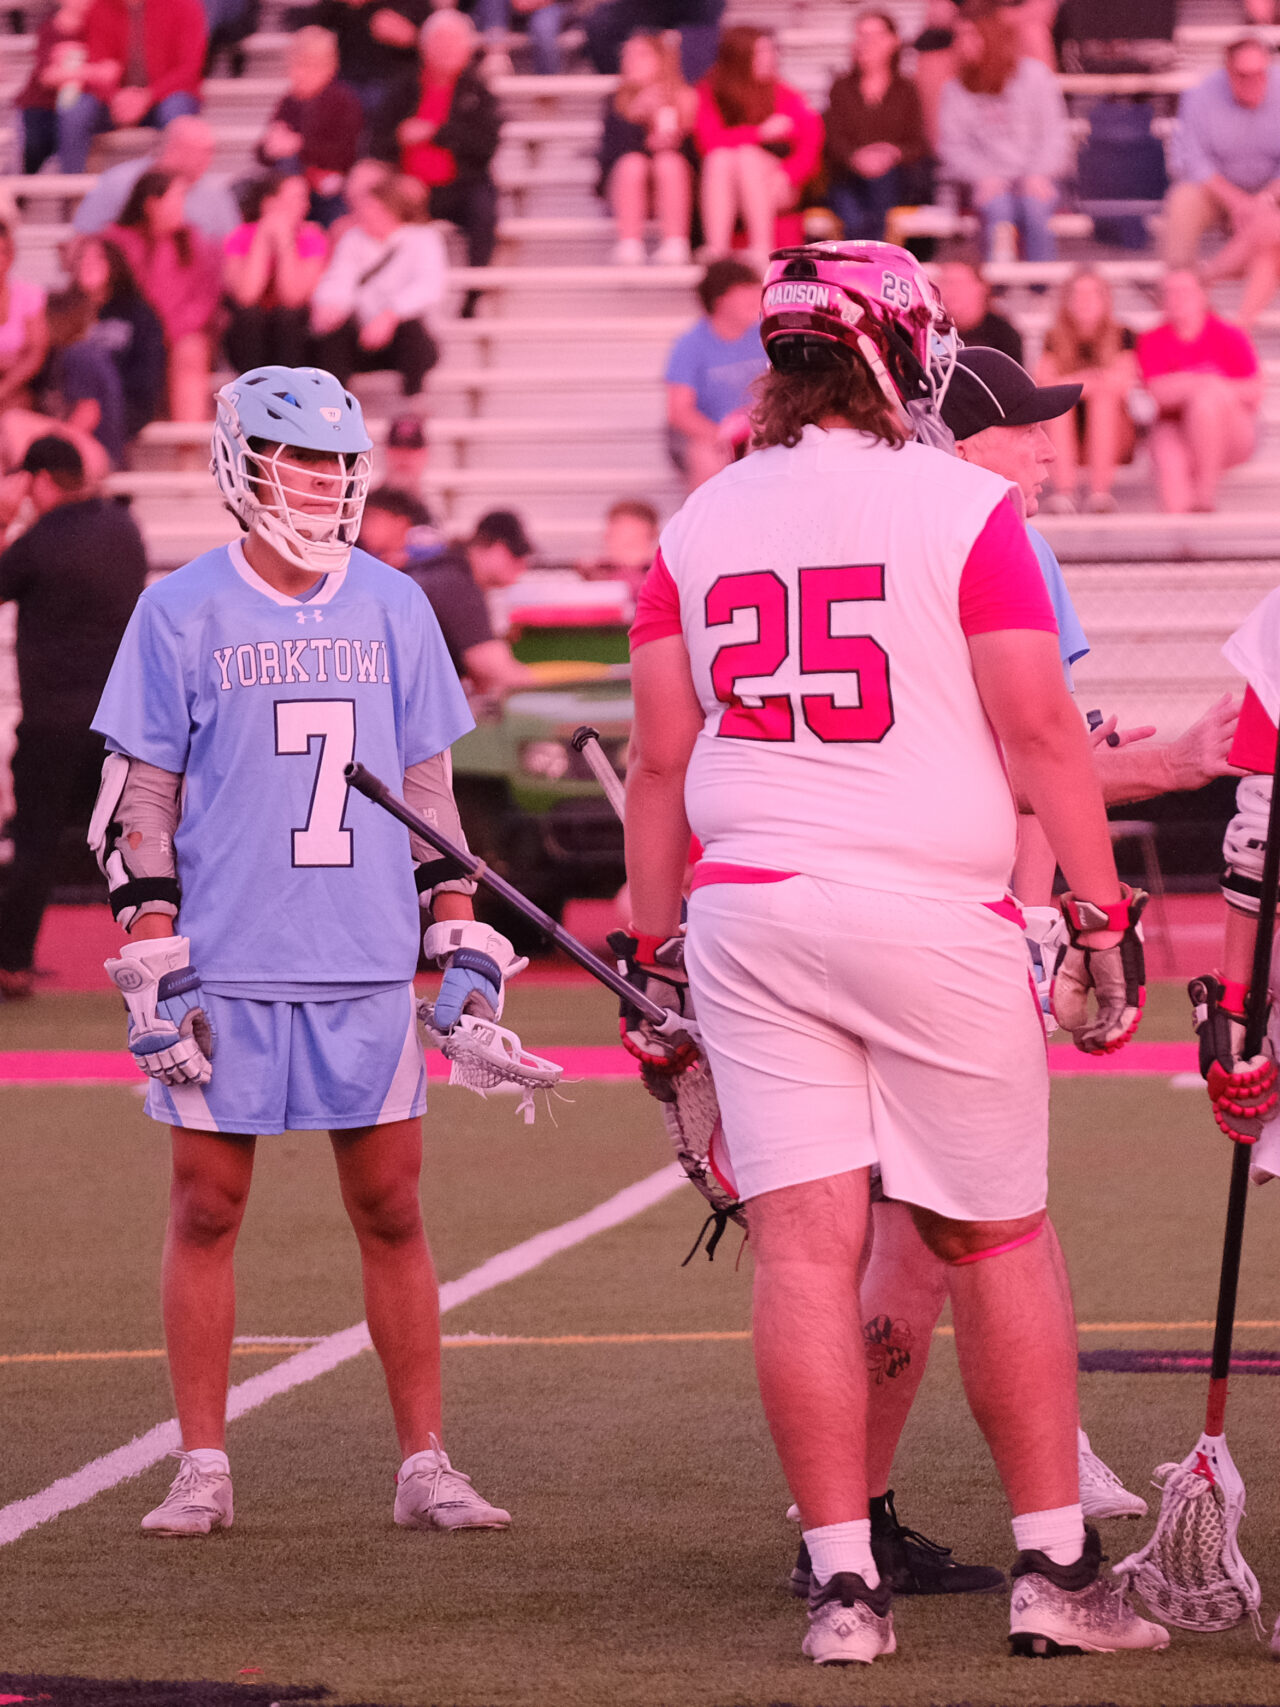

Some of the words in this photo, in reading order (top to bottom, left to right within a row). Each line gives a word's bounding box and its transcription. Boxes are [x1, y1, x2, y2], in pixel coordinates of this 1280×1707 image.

[768, 284, 830, 308] MADISON
[881, 270, 913, 311] 25
[704, 563, 895, 744] 25
[273, 698, 357, 868] 7
